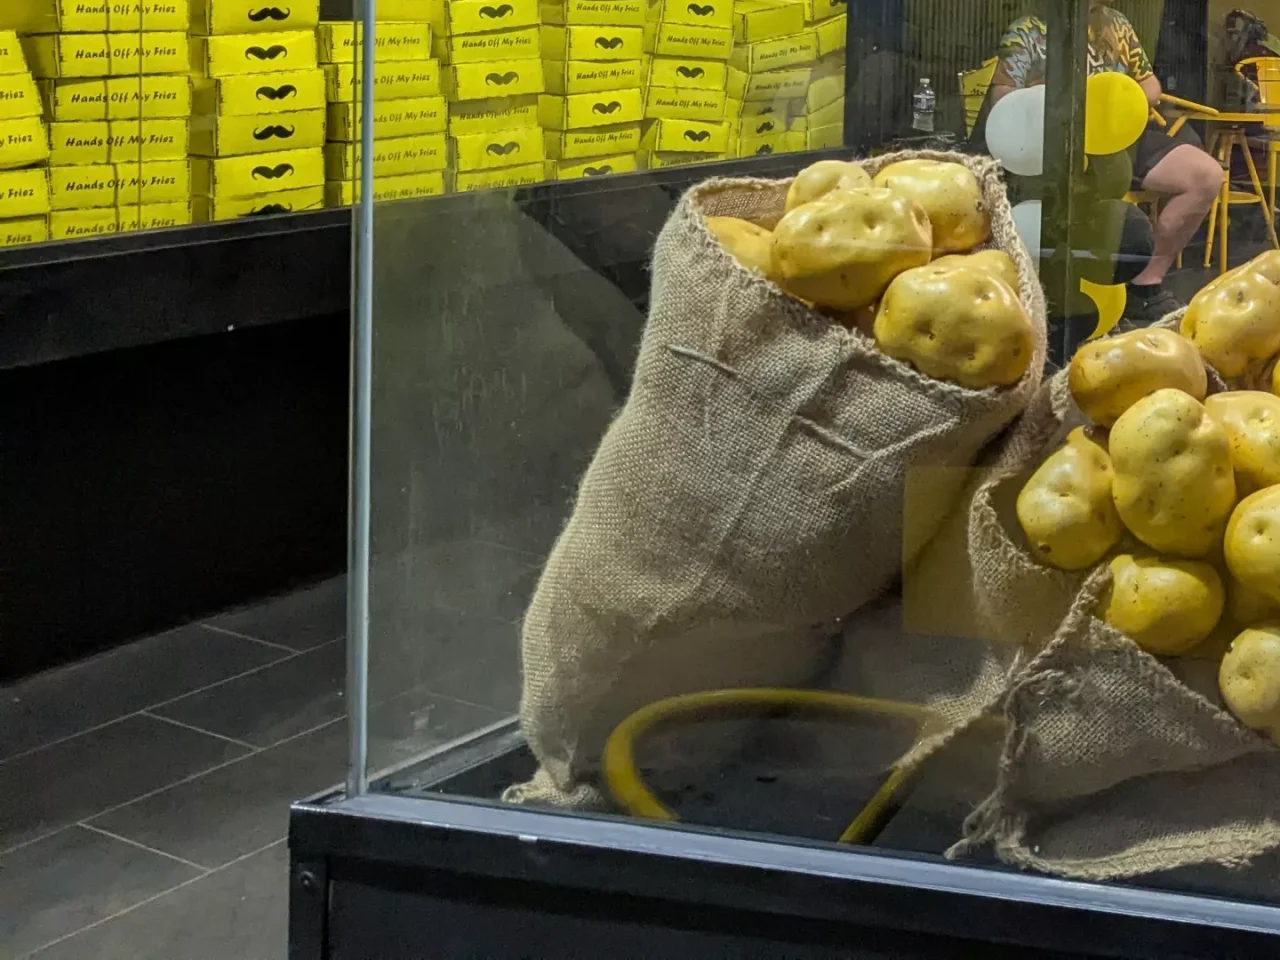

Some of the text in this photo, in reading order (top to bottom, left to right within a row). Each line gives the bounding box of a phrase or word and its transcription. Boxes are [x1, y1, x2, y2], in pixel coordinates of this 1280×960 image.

[76, 4, 110, 13] Hands
[113, 5, 130, 15] Off
[153, 4, 176, 13] Friez
[576, 4, 599, 12] Hands
[600, 4, 611, 13] Off
[612, 5, 624, 13] My
[387, 37, 401, 46] My
[462, 40, 486, 48] Hands
[488, 38, 500, 47] Off
[501, 37, 513, 46] My
[667, 35, 688, 44] Hands
[688, 37, 700, 45] Off
[701, 38, 711, 46] My
[75, 49, 110, 59] Hands
[113, 49, 130, 58] Off
[154, 47, 177, 56] Friez
[380, 76, 394, 85] Off
[396, 75, 410, 83] My
[411, 73, 430, 81] Friez
[576, 72, 598, 80] Hands
[598, 71, 609, 79] Off
[610, 70, 621, 78] My
[71, 93, 108, 103] Hands
[111, 92, 129, 103] Off
[153, 92, 177, 100] Friez
[656, 99, 678, 107] Hands
[691, 100, 702, 108] My
[389, 113, 402, 122] Off
[404, 111, 418, 120] My
[8, 134, 33, 144] Friez
[66, 135, 174, 147] Hands Off My Friez
[608, 134, 618, 142] My
[387, 151, 401, 160] Off
[403, 150, 418, 159] My
[66, 177, 175, 191] Hands Off My Friez
[8, 189, 34, 198] Friez
[400, 188, 414, 197] My
[65, 218, 176, 235] Hands Off My Friez
[6, 234, 32, 244] Friez
